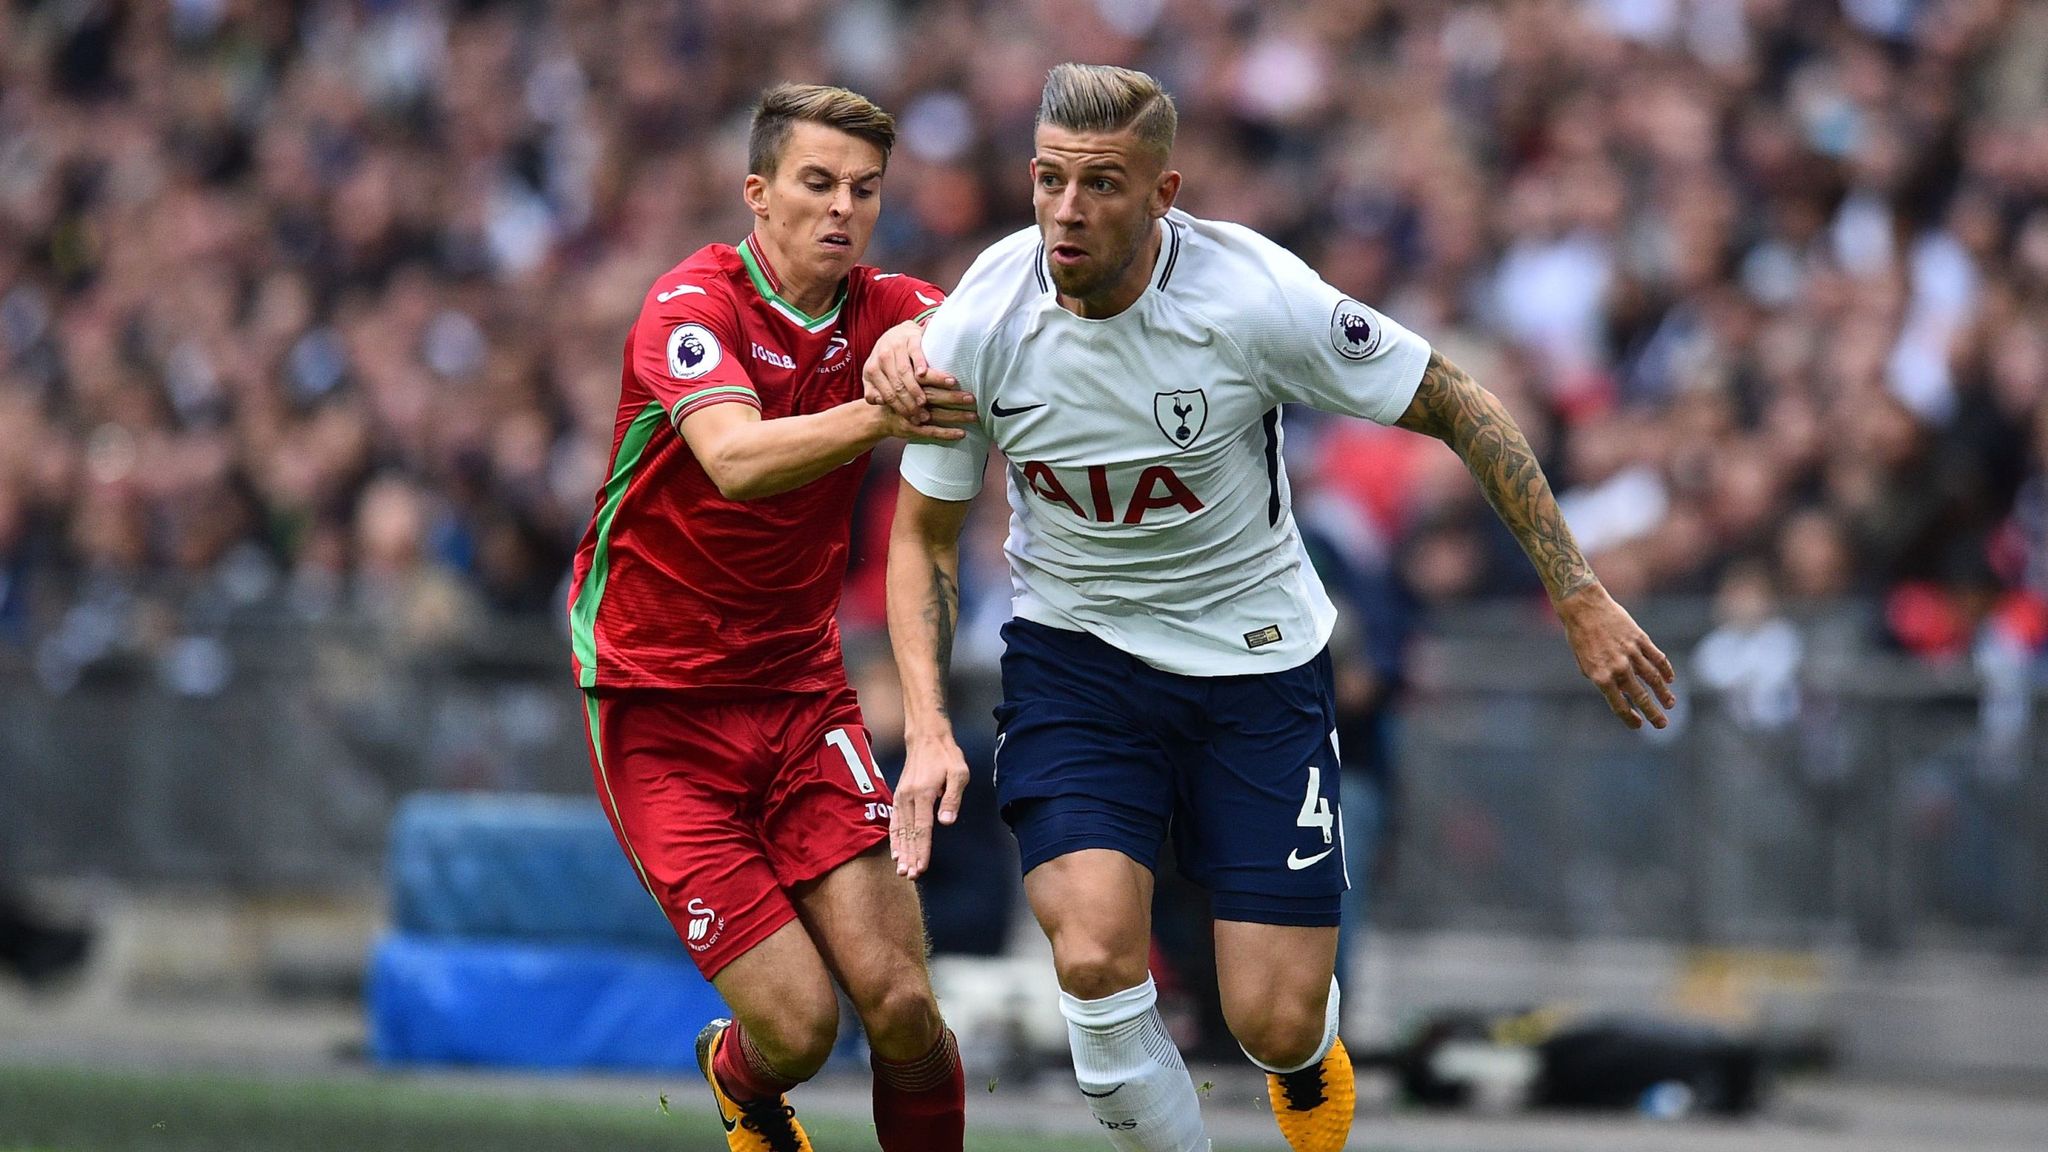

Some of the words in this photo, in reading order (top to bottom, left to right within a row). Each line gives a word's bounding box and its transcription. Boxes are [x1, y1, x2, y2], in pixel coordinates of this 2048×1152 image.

[1023, 460, 1206, 525] AIA
[824, 728, 885, 795] 1
[1296, 766, 1334, 844] 4
